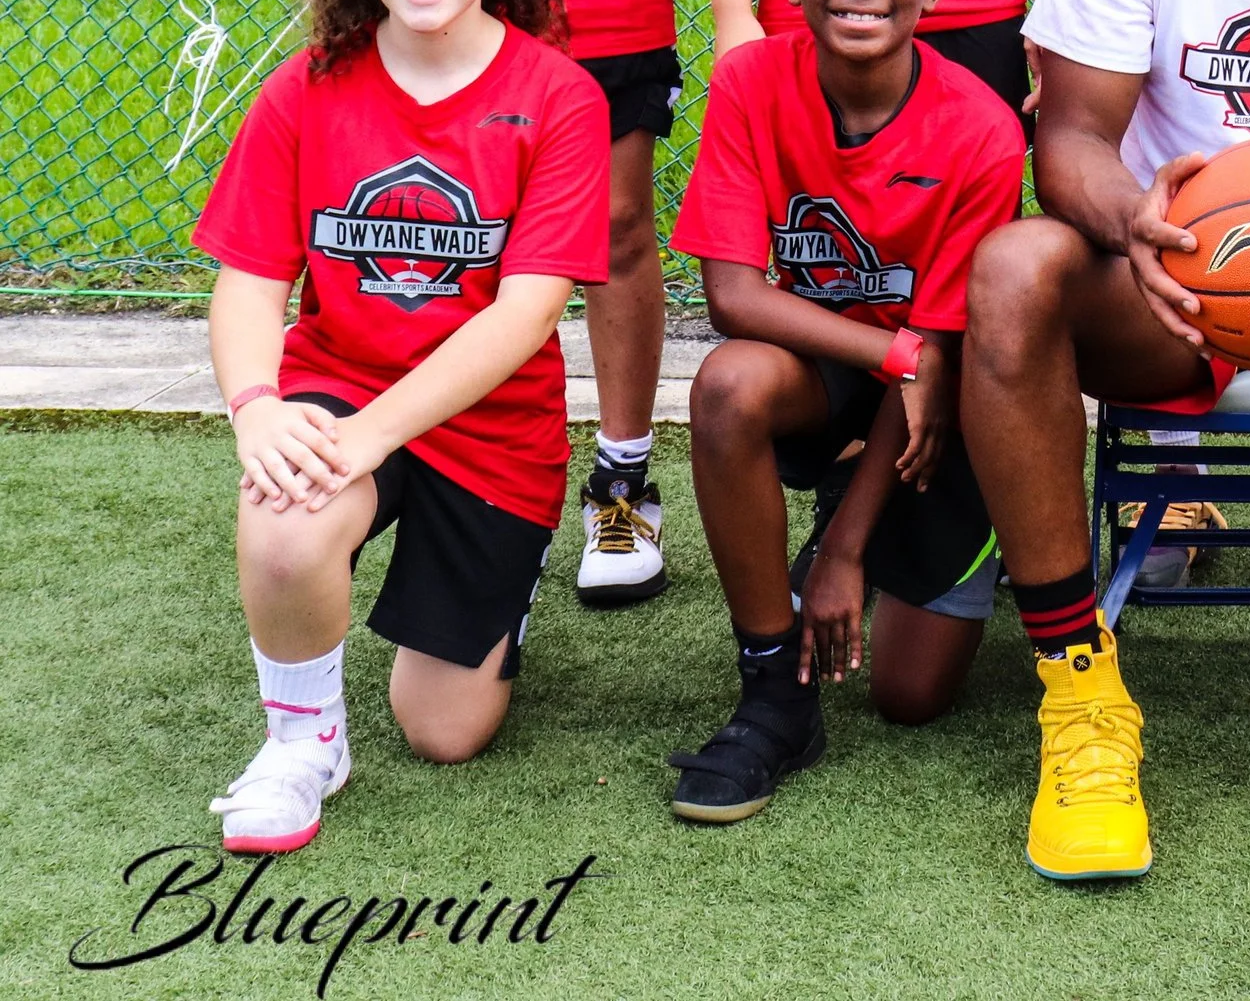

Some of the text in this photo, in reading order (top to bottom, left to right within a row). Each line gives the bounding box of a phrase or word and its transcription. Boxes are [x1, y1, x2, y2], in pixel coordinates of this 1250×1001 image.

[336, 221, 490, 255] DWYANE WADE
[775, 235, 842, 259] DWYAN
[369, 283, 453, 293] CELEBRITY SPORTS ACADEMY
